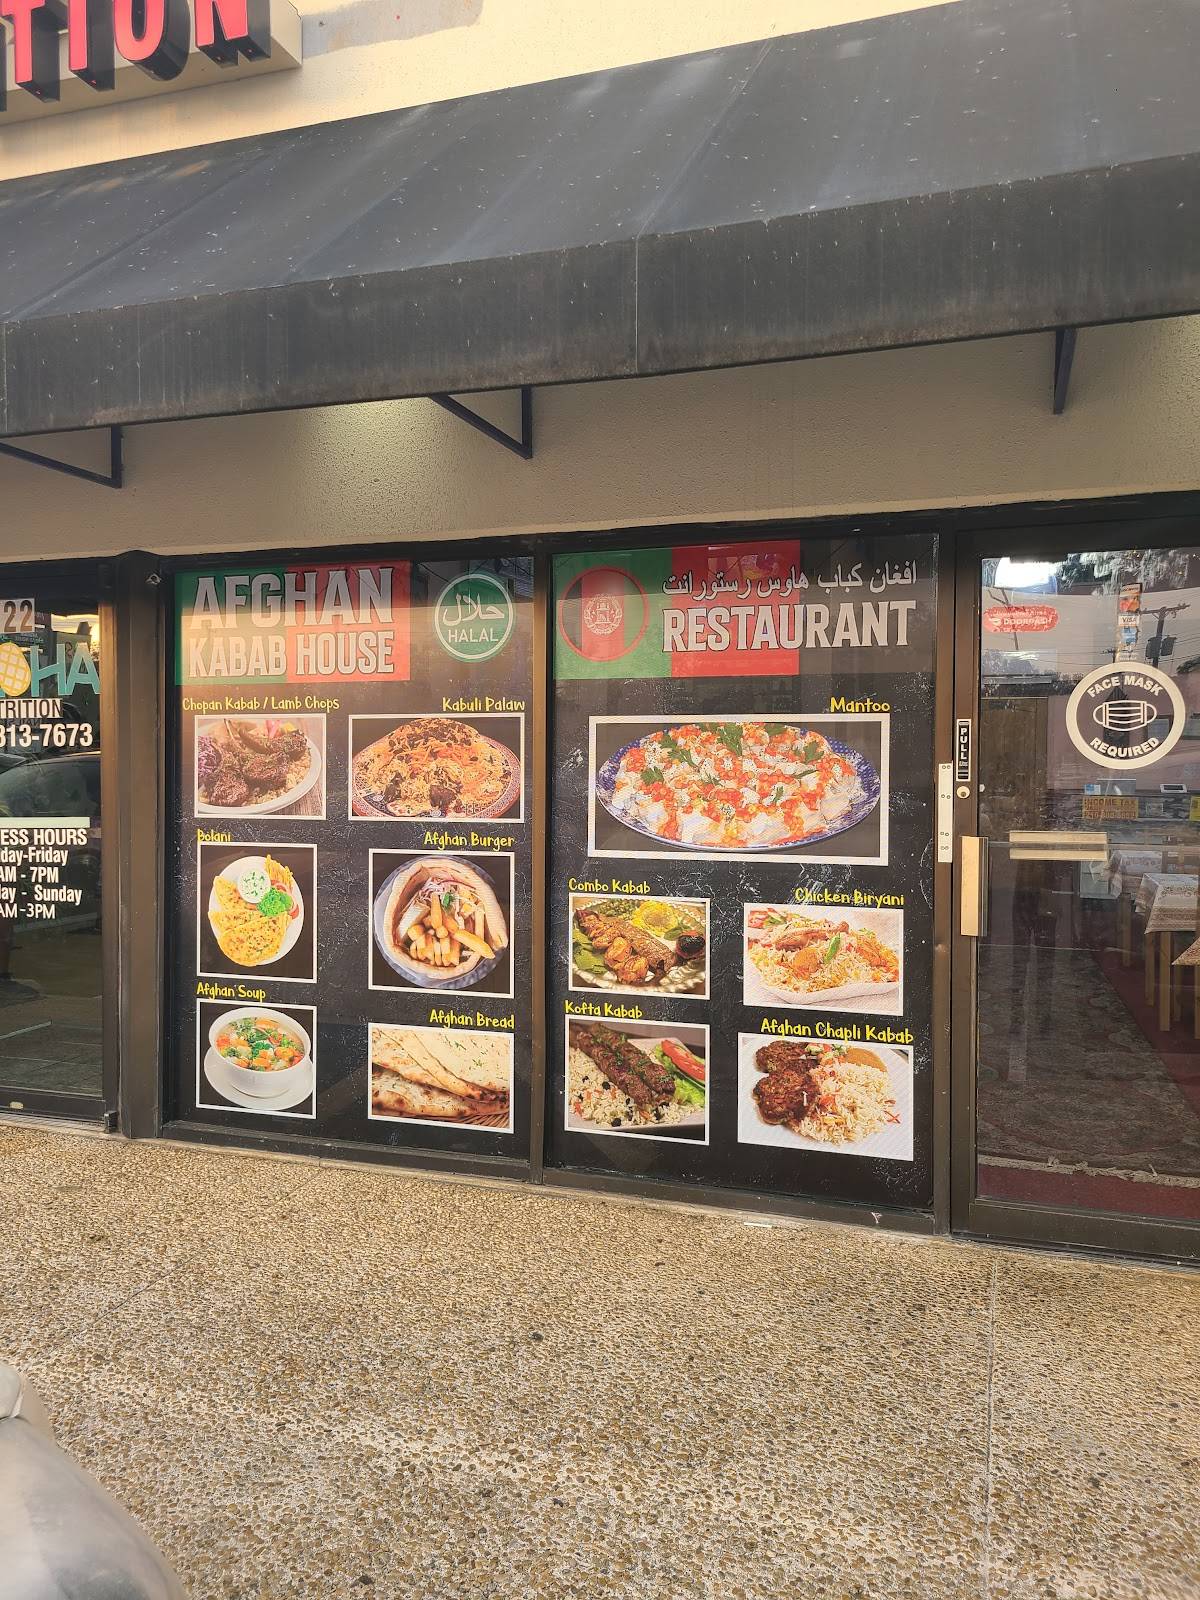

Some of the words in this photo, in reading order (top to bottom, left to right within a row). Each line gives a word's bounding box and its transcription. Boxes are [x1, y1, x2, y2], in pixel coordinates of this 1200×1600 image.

[757, 566, 809, 597] هاوس
[818, 562, 863, 594] کباب
[870, 559, 917, 594] افغان
[190, 567, 394, 631] AFGHAN
[442, 592, 505, 626] حلال
[4, 600, 33, 633] 22
[663, 600, 917, 652] RESTAURANT
[448, 627, 499, 643] HALAL
[188, 634, 288, 679] KABAB
[296, 629, 395, 676] HOUSE
[1087, 676, 1120, 698] FACE
[1124, 675, 1163, 696] MASK
[182, 697, 222, 713] Chopan
[225, 697, 260, 711] Kabab
[271, 697, 303, 711] Lamb
[305, 697, 340, 714] Chops
[442, 698, 482, 712] Kabuli
[485, 698, 526, 712] Palaw
[830, 696, 890, 713] Mantoo
[960, 727, 968, 760] PULL
[1090, 737, 1160, 758] REQUIRED
[0, 828, 29, 846] ESS
[33, 828, 88, 846] HOURS
[197, 829, 231, 843] Bolani
[424, 831, 467, 850] Afghan
[470, 833, 515, 851] Burger
[29, 866, 59, 883] 7PM
[34, 884, 83, 906] Sunday
[568, 878, 610, 893] Combo
[612, 879, 651, 894] Kabab
[795, 887, 850, 904] Chicken
[853, 888, 904, 908] Biryani
[197, 982, 235, 999] Afghan
[238, 984, 266, 1003] Soup
[429, 1009, 474, 1028] Afghan
[477, 1012, 515, 1029] Bread
[565, 1000, 602, 1016] Kofta
[604, 1002, 643, 1019] Kabab
[760, 1017, 812, 1039] Afghan
[815, 1020, 861, 1043] Chapli
[866, 1024, 914, 1043] Kabab
